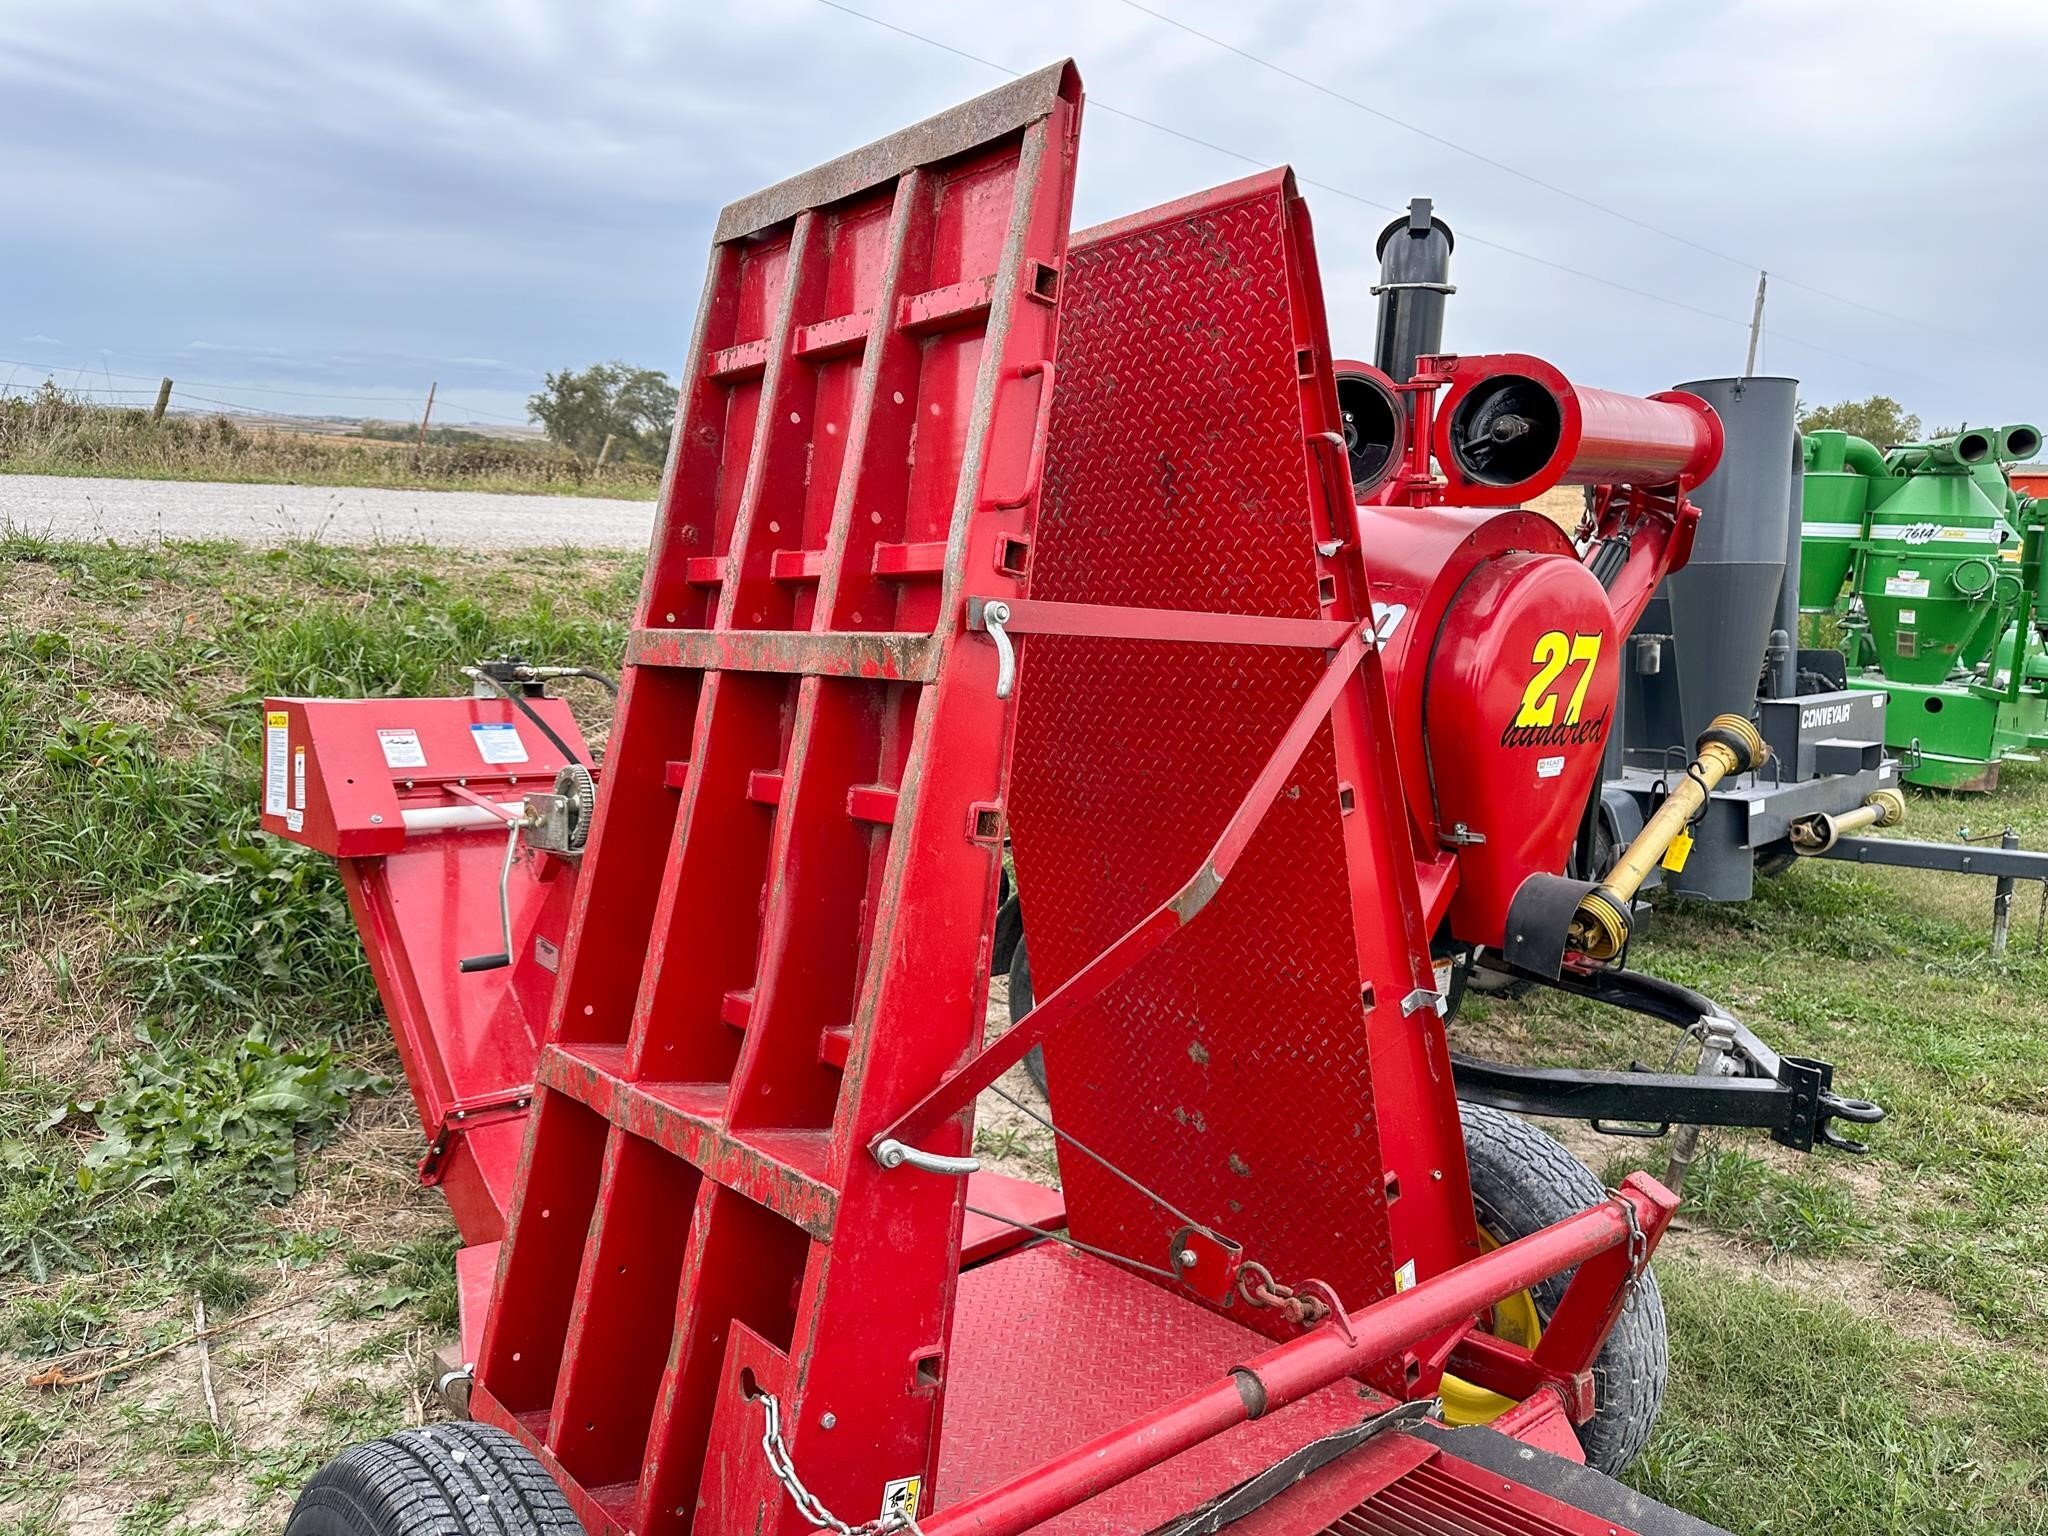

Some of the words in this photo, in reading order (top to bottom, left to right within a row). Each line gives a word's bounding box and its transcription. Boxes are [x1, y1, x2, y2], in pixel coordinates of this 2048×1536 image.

[1904, 528, 1935, 539] 7614
[1514, 629, 1603, 729] 27
[1500, 703, 1609, 748] hundred
[1801, 703, 1851, 729] CONVEYAIR
